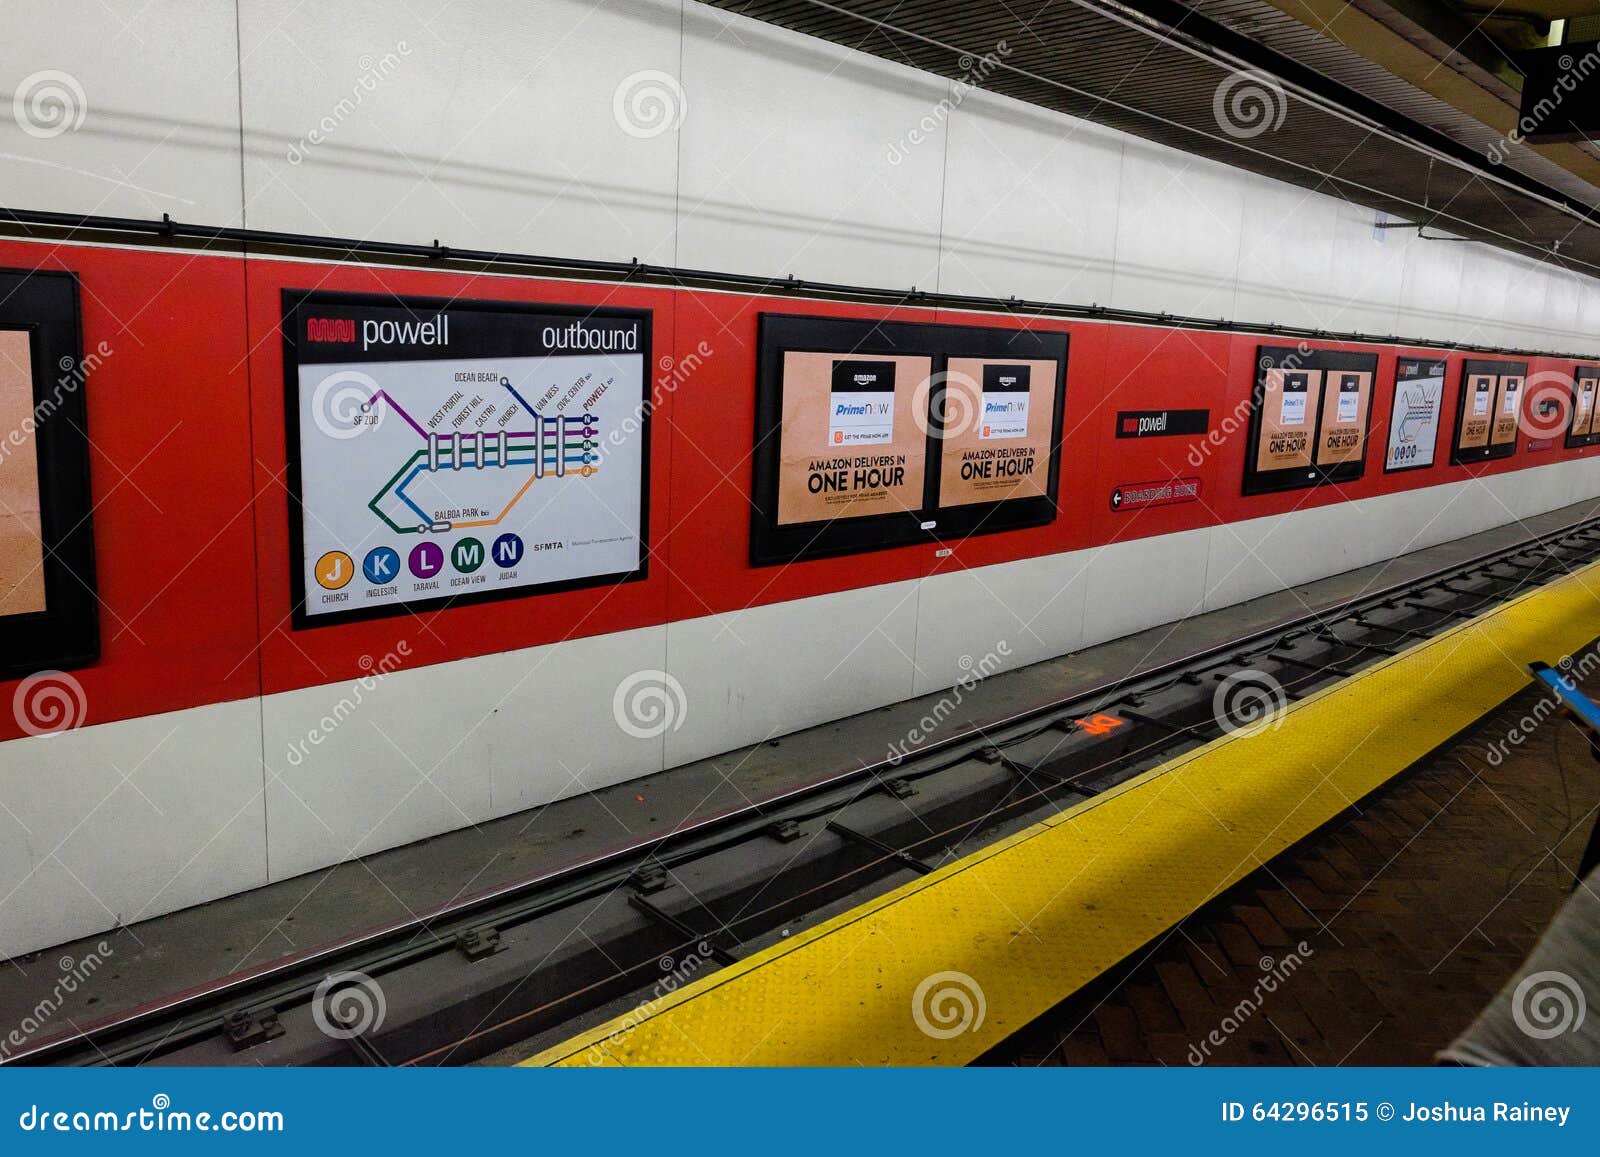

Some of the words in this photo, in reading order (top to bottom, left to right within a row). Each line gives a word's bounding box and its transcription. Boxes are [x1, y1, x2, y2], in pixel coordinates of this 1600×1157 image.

[363, 314, 449, 351] powell
[542, 323, 637, 351] outbound
[454, 372, 476, 382] OCEAN
[477, 371, 498, 382] BEACH
[535, 397, 549, 411] VAN
[544, 384, 560, 398] NESS
[567, 377, 586, 399] CENTER
[582, 383, 609, 411] POWELL
[353, 415, 363, 426] SF
[427, 410, 446, 429] WEST
[441, 390, 464, 413] PORTAL
[451, 406, 473, 429] FOREST
[469, 395, 483, 409] HILL
[474, 404, 496, 428] CASTRO
[497, 403, 519, 427] CHURCH
[1138, 412, 1167, 436] powell
[1269, 441, 1285, 453] ONE
[1285, 438, 1307, 452] HOUR
[1327, 436, 1341, 448] ONE
[1341, 435, 1359, 447] HOUR
[808, 458, 852, 471] AMAZON
[854, 455, 895, 468] DELIVERS
[896, 455, 906, 465] IN
[962, 449, 996, 461] AMAZON
[997, 447, 1028, 459] DELIVERS
[1028, 447, 1036, 457] IN
[960, 460, 993, 480] ONE
[995, 457, 1034, 478] HOUR
[807, 471, 848, 494] ONE
[853, 466, 905, 490] HOUR
[1124, 485, 1172, 504] BOARDING
[1174, 483, 1198, 498] ZONE
[434, 510, 461, 520] BALBOA
[462, 508, 479, 518] PARK
[456, 544, 480, 567] M
[499, 540, 518, 561] N
[533, 541, 564, 552] SFMTA
[325, 559, 342, 582] J
[373, 554, 392, 577] K
[419, 549, 435, 571] L
[413, 581, 441, 593] TARAVAL
[450, 575, 471, 588] OCEAN
[470, 574, 487, 586] VIEW
[497, 571, 519, 582] JUDAH
[321, 592, 350, 604] CHURCH
[366, 586, 399, 599] INGLESIDE
